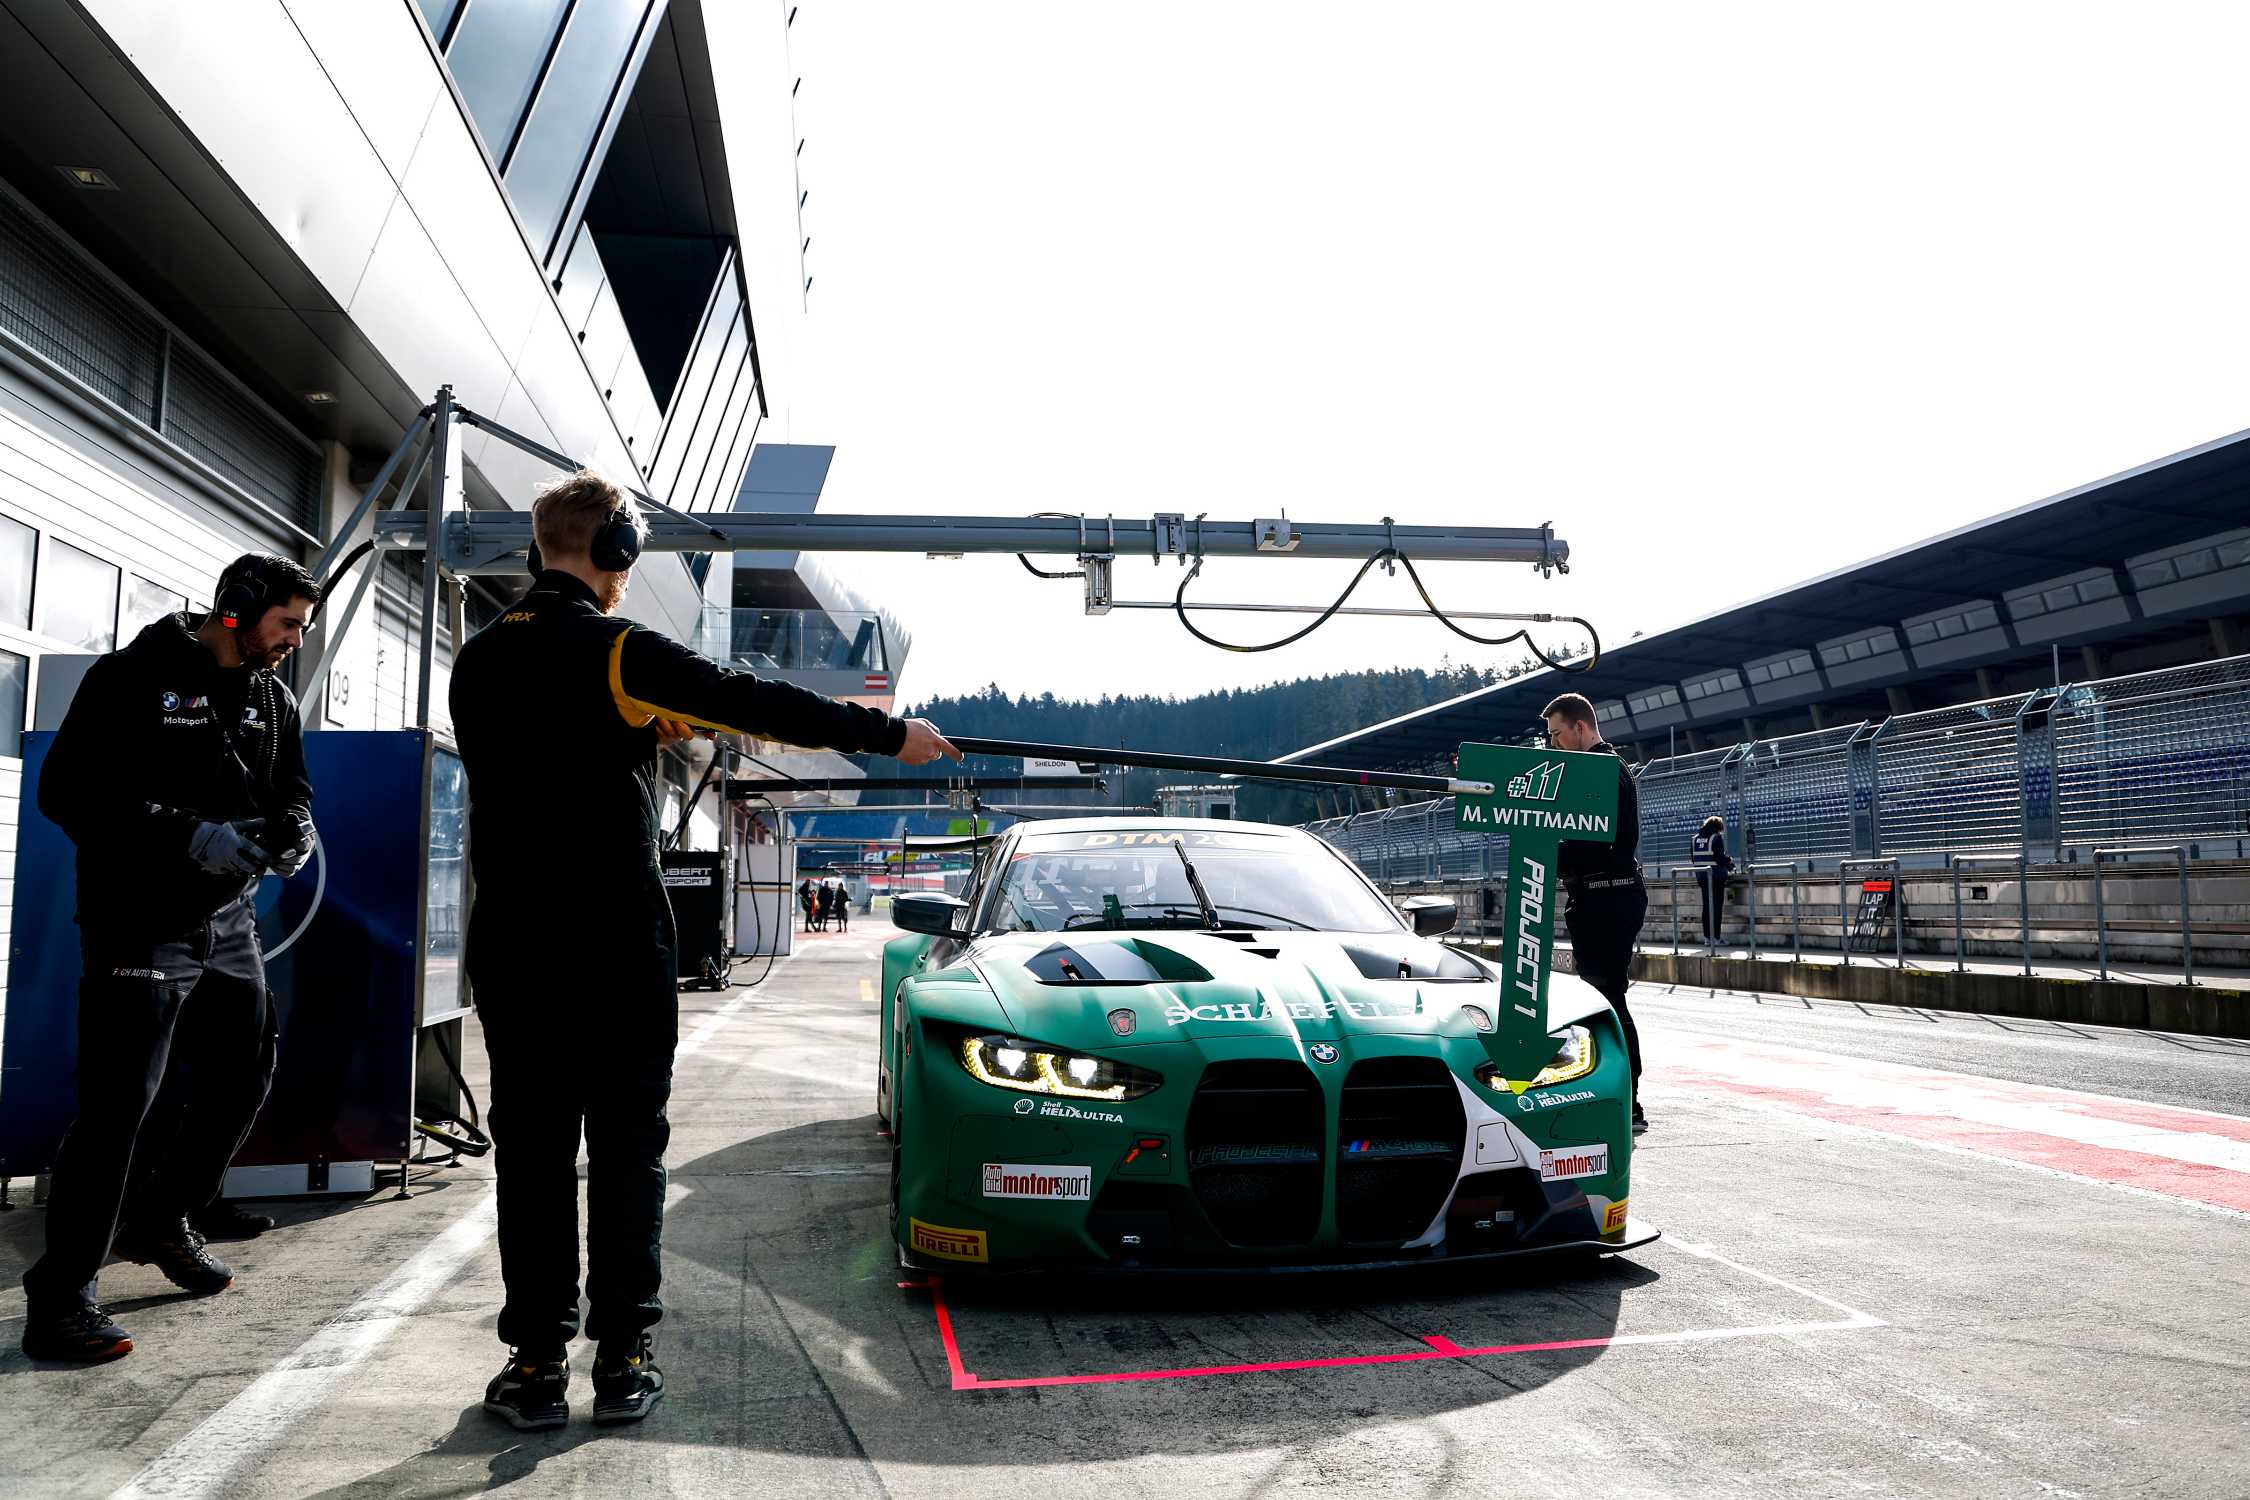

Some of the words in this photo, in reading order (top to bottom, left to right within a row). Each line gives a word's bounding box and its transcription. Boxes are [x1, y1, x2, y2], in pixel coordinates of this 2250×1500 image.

[332, 671, 349, 705] 09
[163, 717, 208, 725] Motorsport
[1507, 760, 1566, 801] #11
[1462, 804, 1488, 823] M.
[1493, 807, 1610, 833] WITTMANN
[1083, 832, 1186, 846] DTM
[664, 878, 706, 886] SPORT
[1865, 893, 1883, 905] LAP
[1867, 907, 1878, 919] IT
[1515, 856, 1545, 1001] PROJECT
[112, 967, 131, 977] FCH
[131, 968, 150, 977] AUTO
[1514, 1003, 1537, 1018] 1
[1568, 1091, 1596, 1102] ULTRA
[1040, 1106, 1082, 1118] HELIX
[1082, 1111, 1124, 1123] ULTRA
[1555, 1152, 1607, 1176] motorsport
[1003, 1174, 1088, 1198] motorsport
[914, 1224, 980, 1256] PIRELLI
